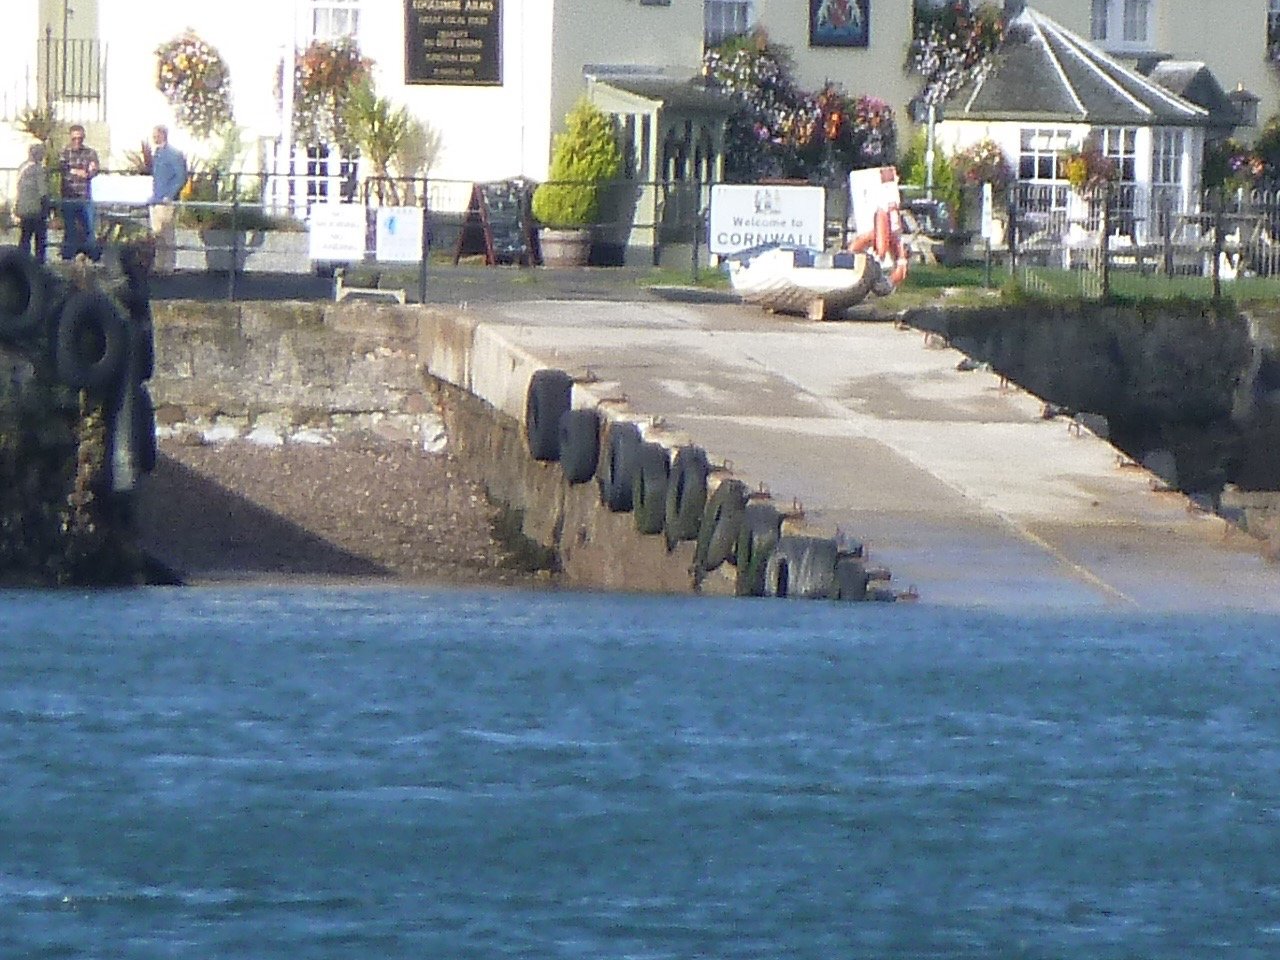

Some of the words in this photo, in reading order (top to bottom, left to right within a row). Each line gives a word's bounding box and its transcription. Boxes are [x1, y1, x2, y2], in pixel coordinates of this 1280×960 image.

[733, 216, 787, 227] Welcome
[791, 216, 804, 227] to
[717, 231, 817, 247] CORNWALL
